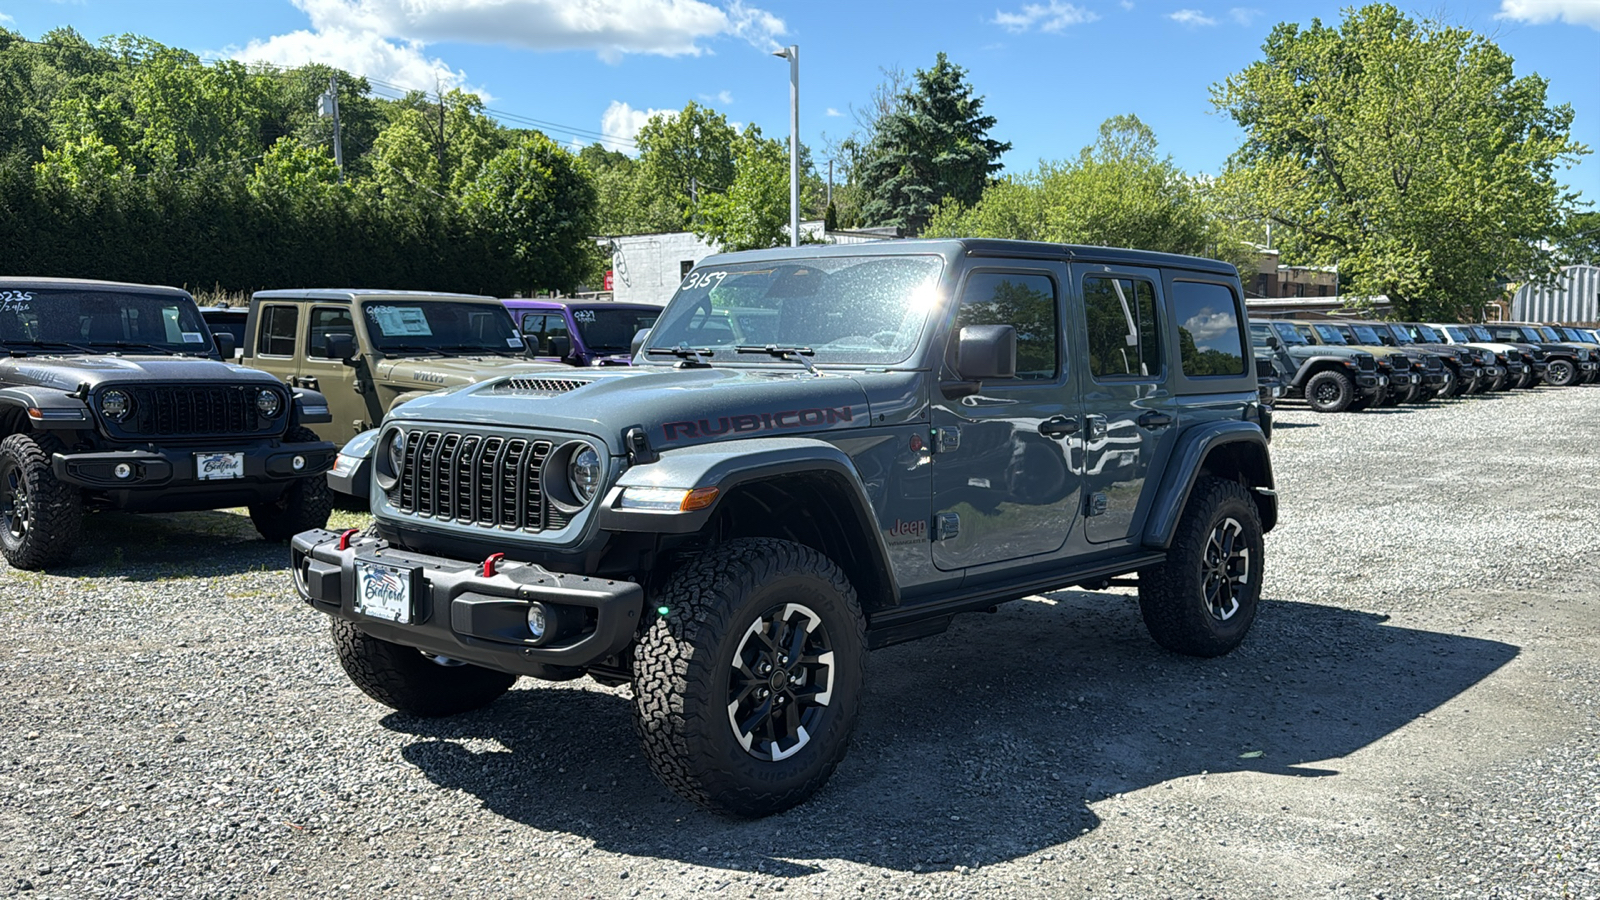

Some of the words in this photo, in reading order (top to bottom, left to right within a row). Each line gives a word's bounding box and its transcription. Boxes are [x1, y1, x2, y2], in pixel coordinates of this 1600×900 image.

[682, 271, 728, 291] 3159
[0, 301, 30, 314] /24/26
[662, 406, 853, 441] RUBICON
[889, 518, 927, 537] Jeep
[363, 574, 406, 606] Bedford
